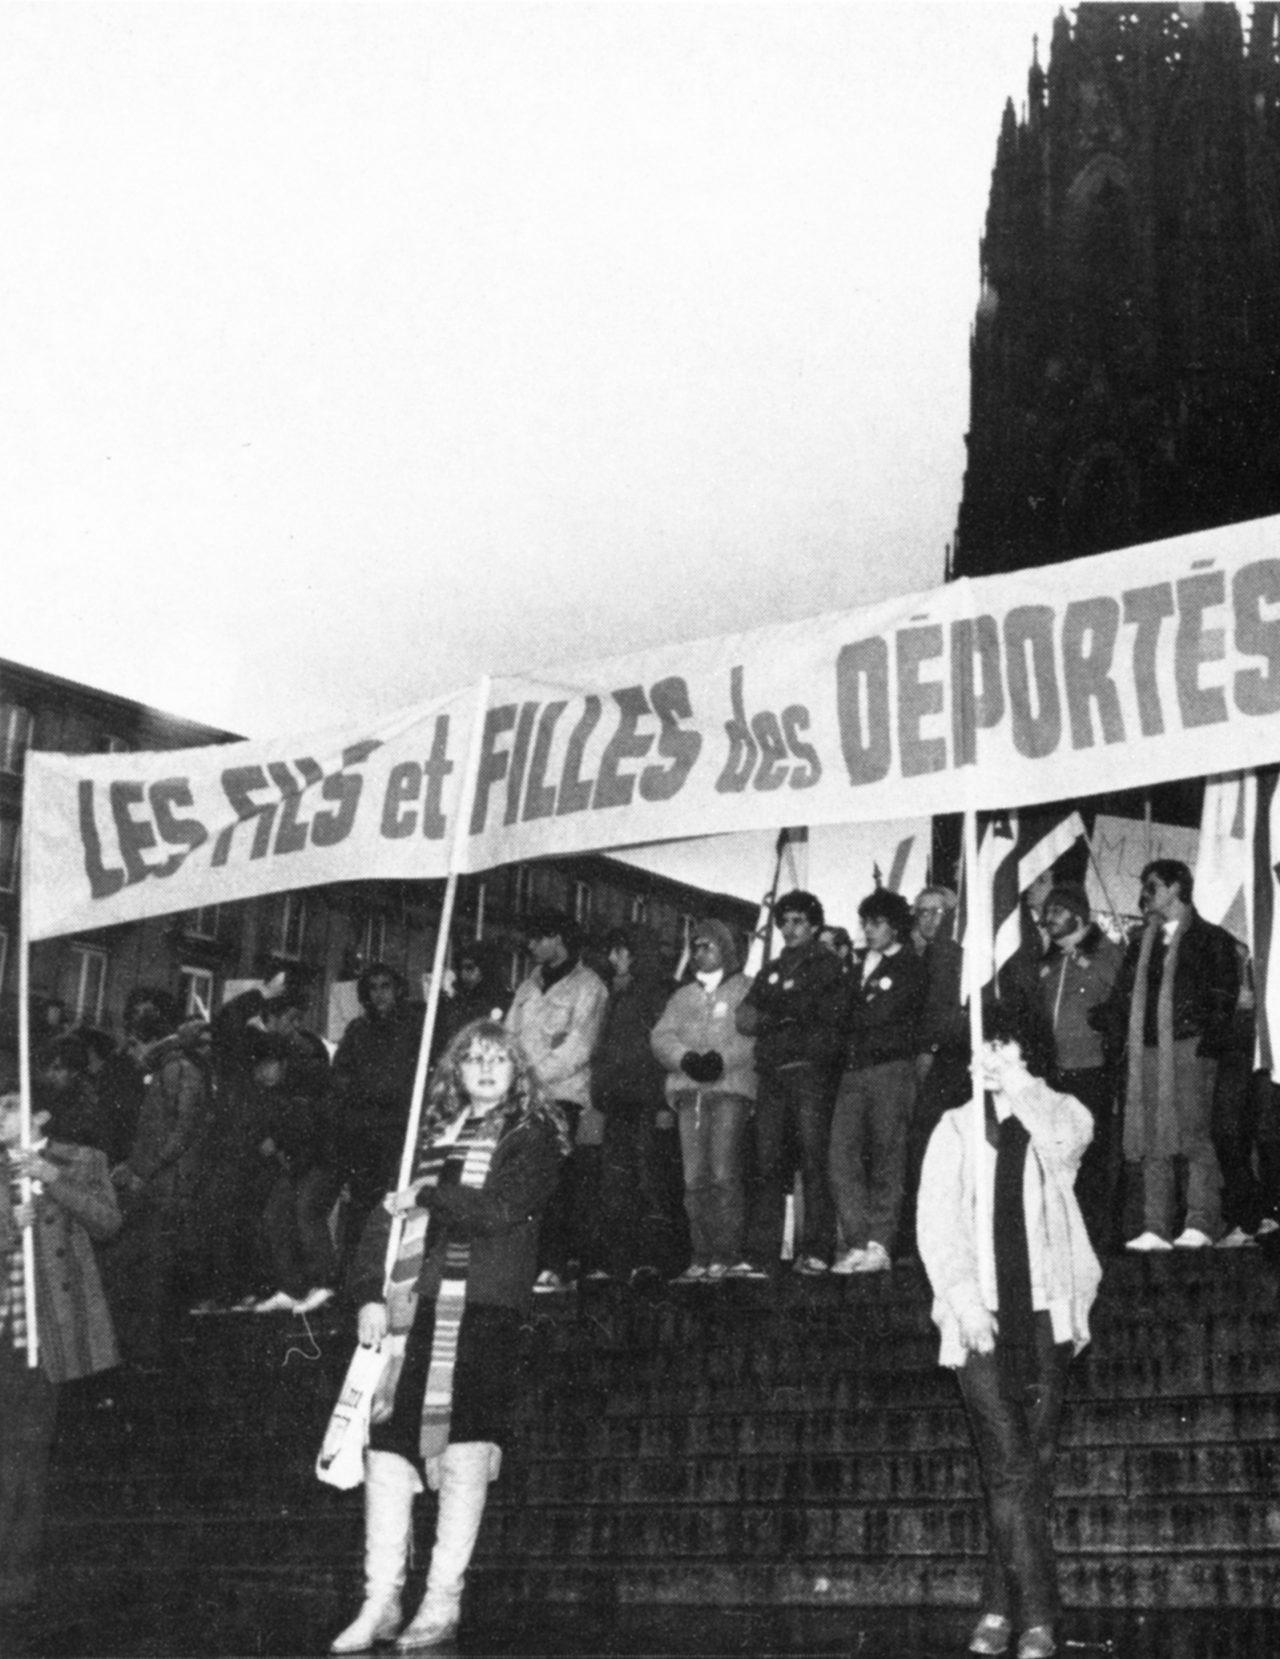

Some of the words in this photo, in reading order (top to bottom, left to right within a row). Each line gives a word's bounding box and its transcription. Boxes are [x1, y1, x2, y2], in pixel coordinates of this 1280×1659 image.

[78, 776, 209, 900] LES
[209, 739, 386, 868] FILS
[380, 713, 454, 841] et
[469, 675, 704, 836] FILLES
[714, 664, 823, 794] des
